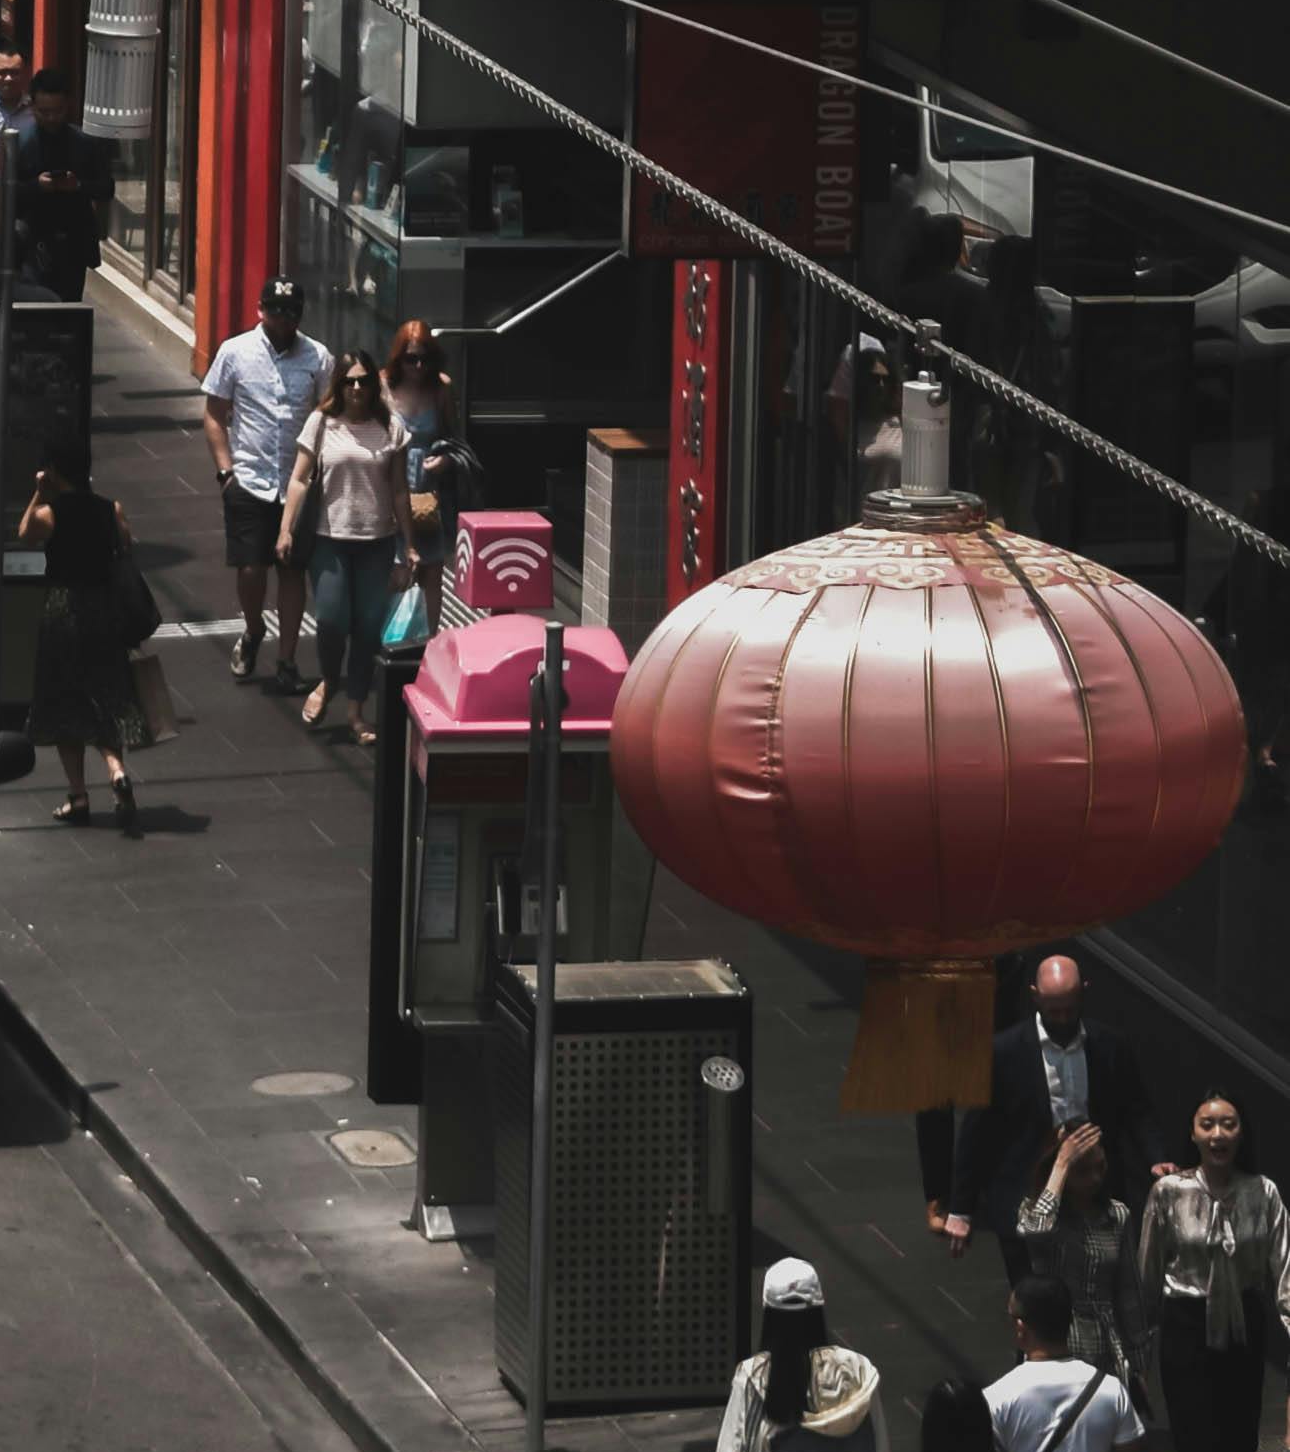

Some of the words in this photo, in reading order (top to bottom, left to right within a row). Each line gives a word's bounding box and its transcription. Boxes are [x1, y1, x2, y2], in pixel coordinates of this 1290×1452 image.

[816, 5, 858, 146] DRAGON
[813, 166, 854, 253] BOAT
[274, 281, 294, 296] M
